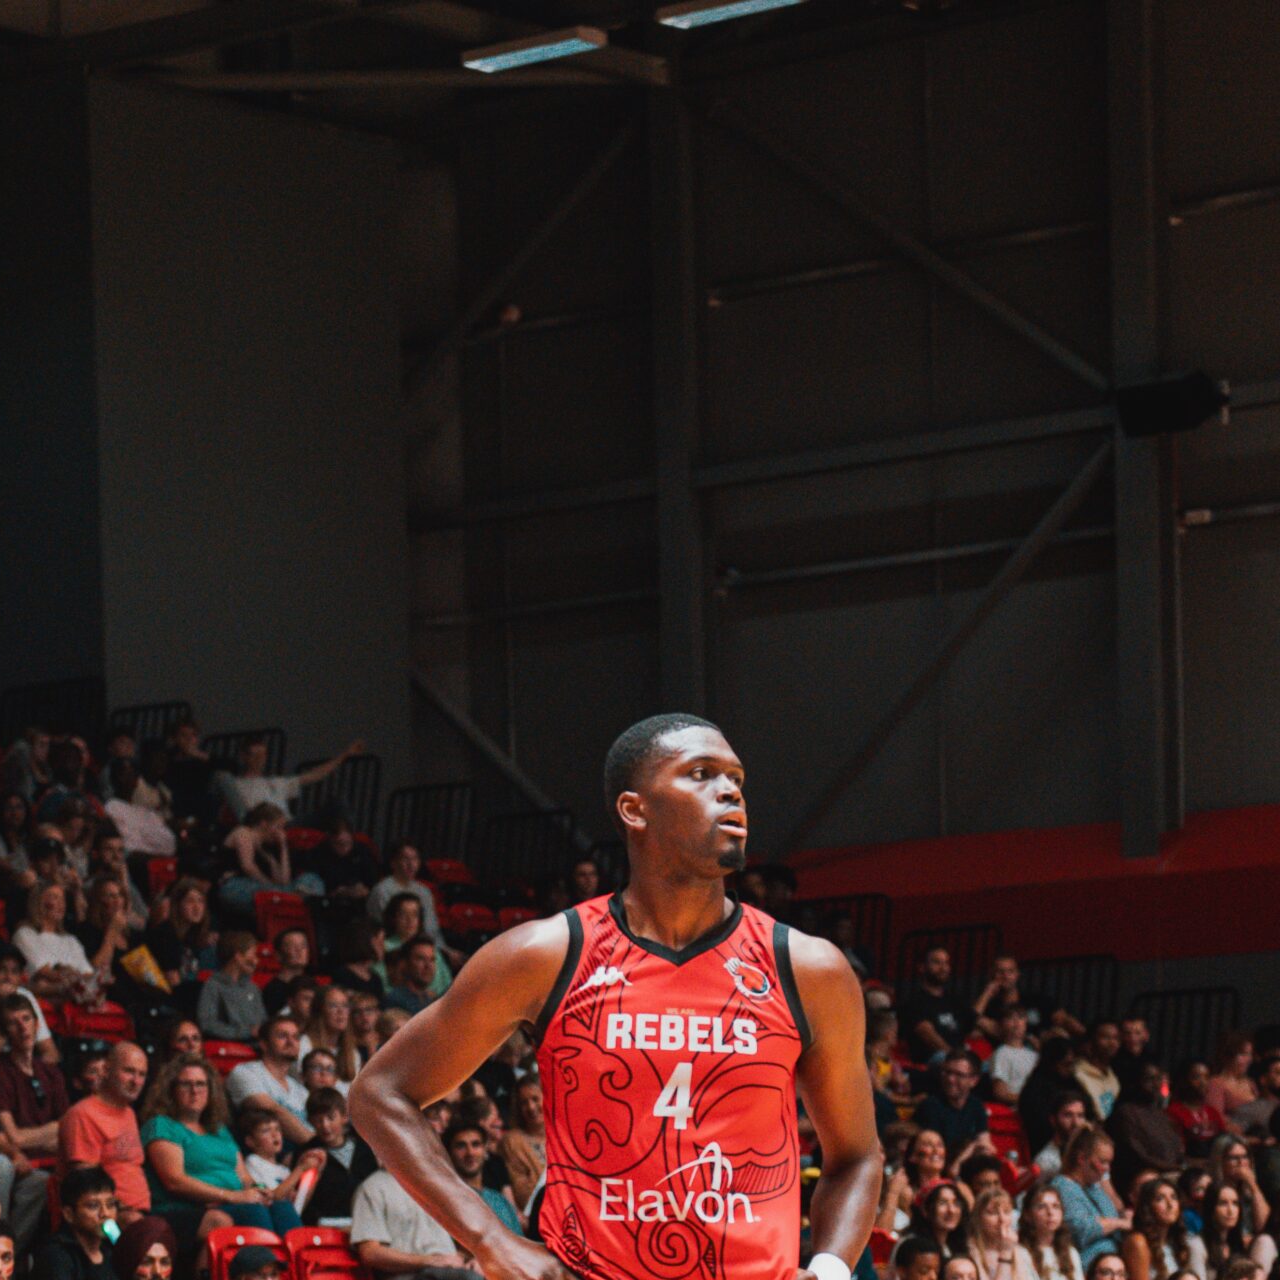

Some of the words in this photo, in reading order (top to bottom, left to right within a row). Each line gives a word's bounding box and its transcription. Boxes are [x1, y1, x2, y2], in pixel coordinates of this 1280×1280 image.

[605, 1013, 758, 1055] REBELS
[652, 1062, 694, 1130] 4
[599, 1177, 754, 1225] Elavon
